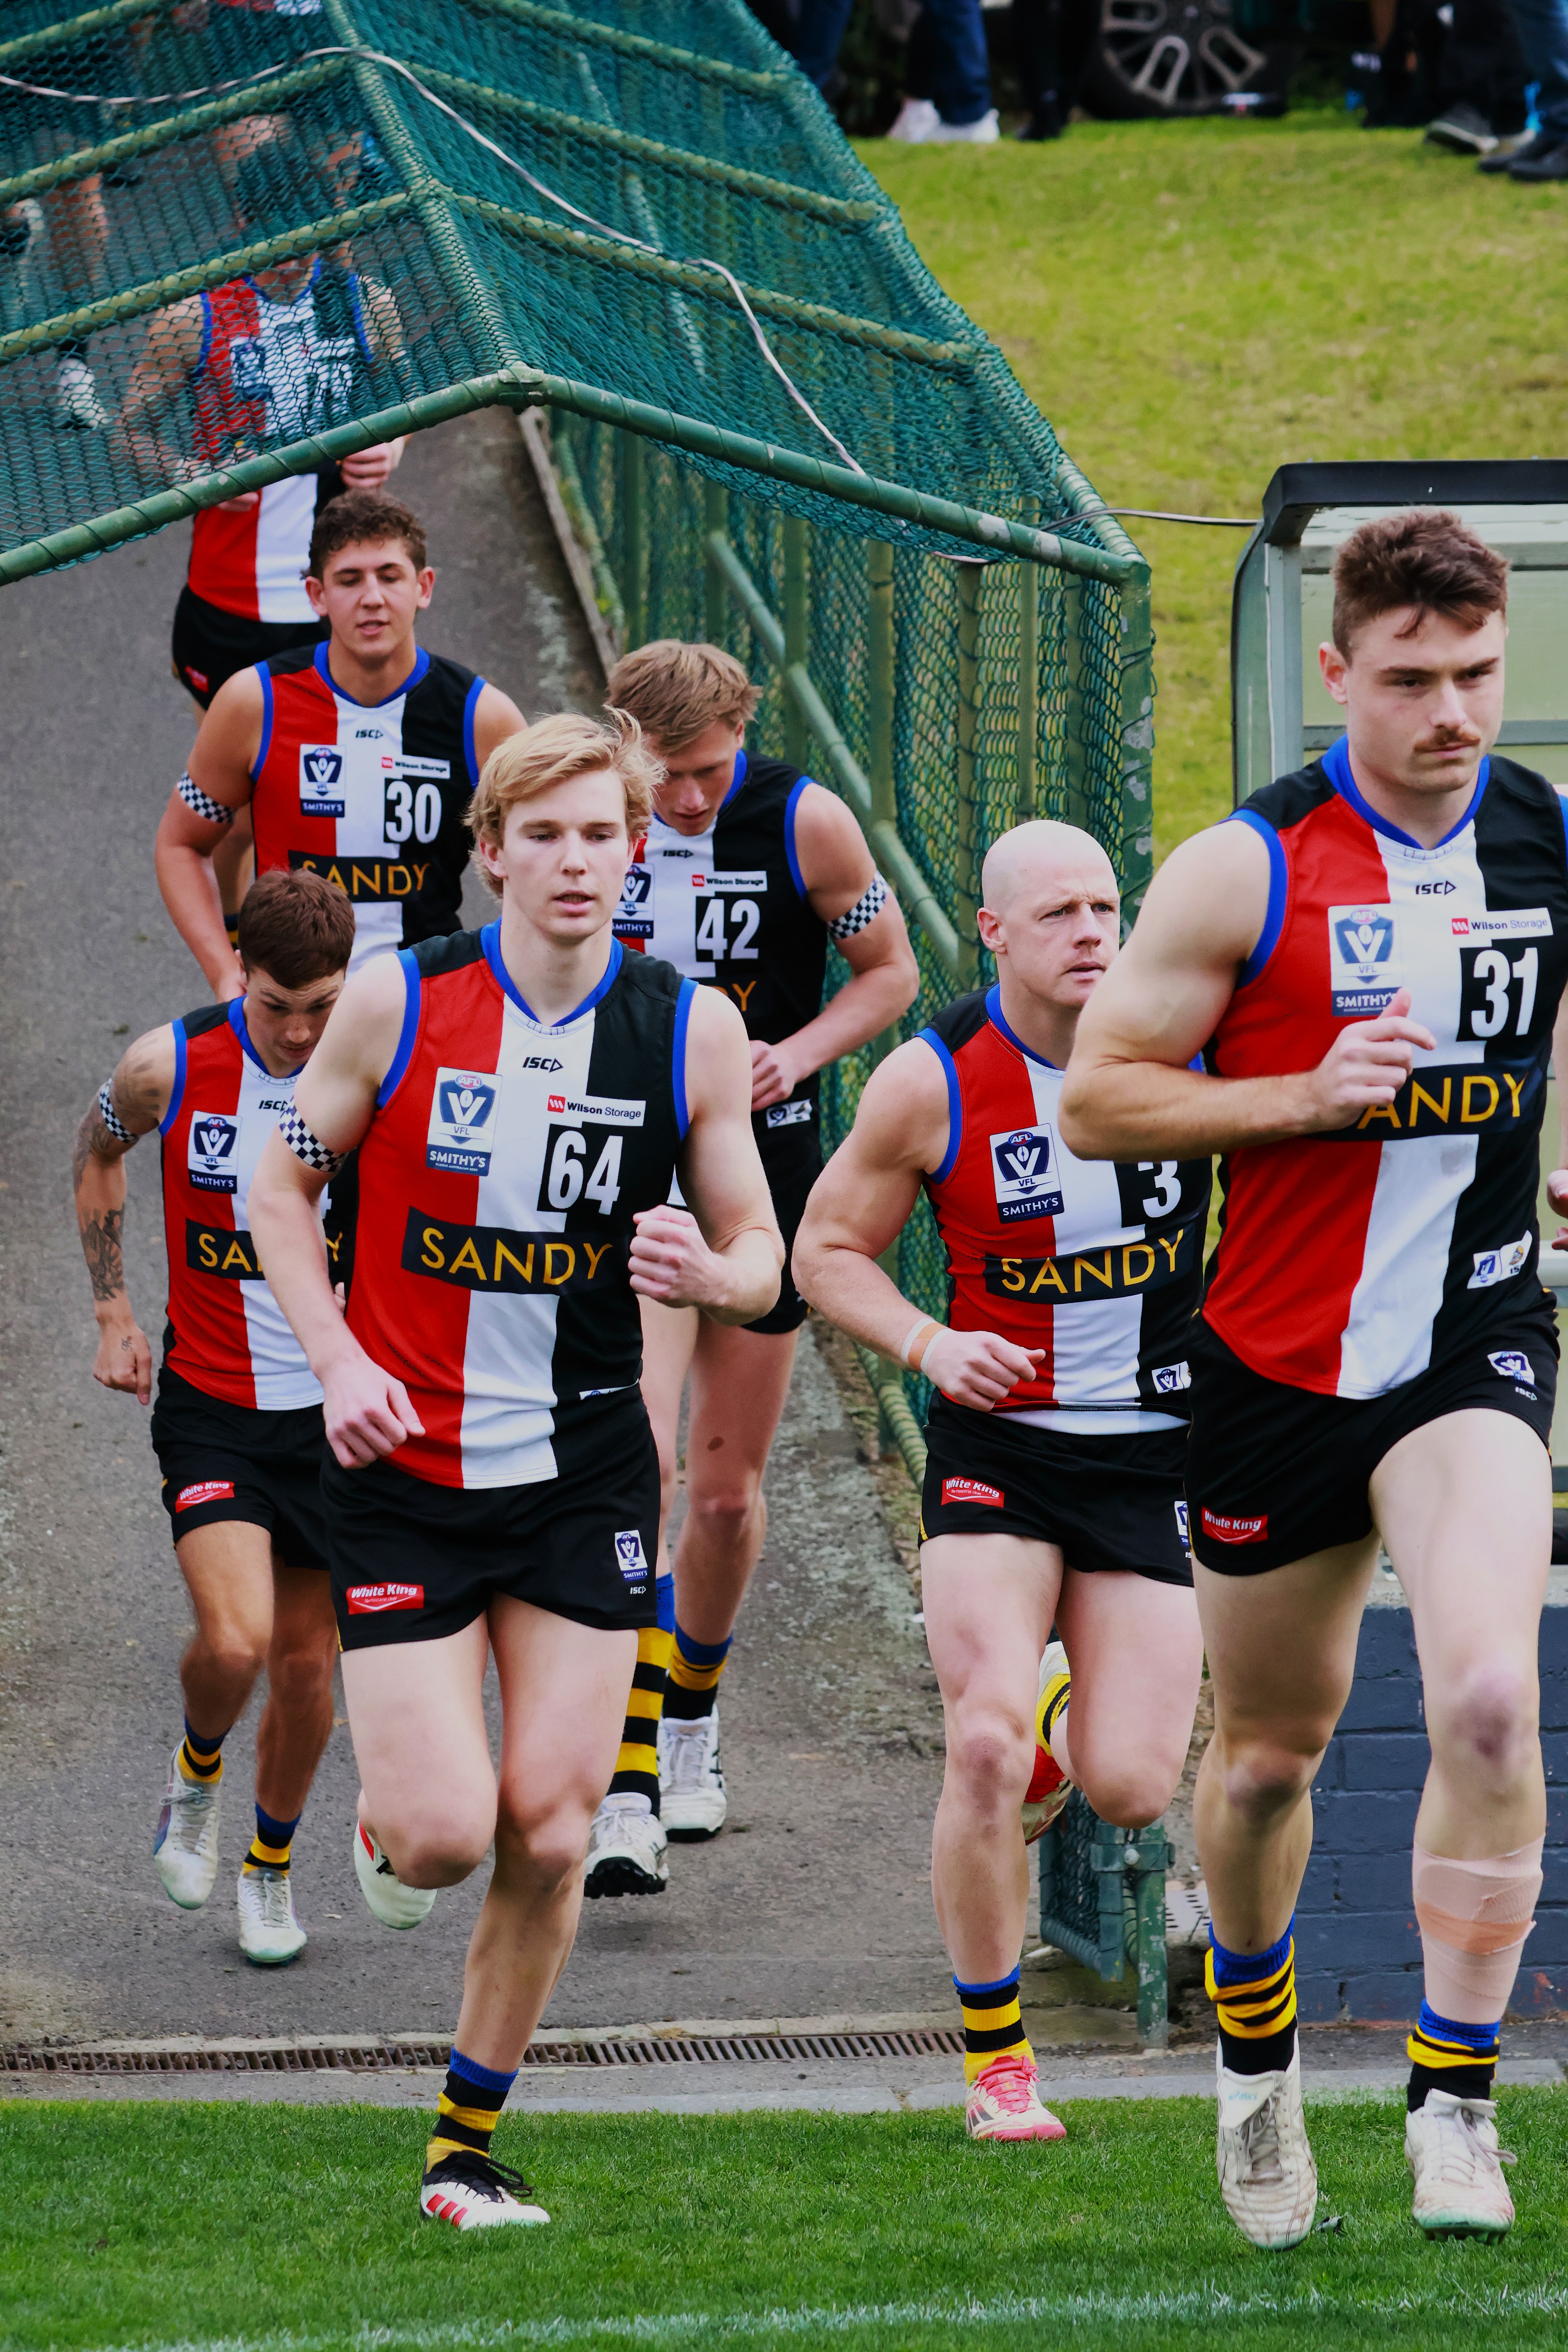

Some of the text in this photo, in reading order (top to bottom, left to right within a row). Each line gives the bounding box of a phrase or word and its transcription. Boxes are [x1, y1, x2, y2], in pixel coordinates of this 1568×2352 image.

[386, 780, 441, 843] 30
[697, 899, 760, 960] 42
[1472, 918, 1548, 931] Wilson Storage
[1471, 947, 1538, 1038] 31
[457, 1075, 479, 1086] AFL
[1357, 1073, 1528, 1129] ANDY
[567, 1102, 641, 1119] Wilson Storage
[454, 1126, 470, 1135] VFL
[1011, 1134, 1032, 1144] AFL
[430, 1150, 486, 1168] SMITHY'S
[191, 1174, 234, 1187] SMITHY'S
[548, 1131, 623, 1215] 64
[1018, 1178, 1036, 1187] VFL
[1002, 1198, 1059, 1216] SMITHY'S
[421, 1227, 613, 1285] SANDY
[1002, 1229, 1184, 1294] SANDY
[180, 1485, 203, 1501] White
[946, 1478, 971, 1490] White
[973, 1482, 1000, 1498] King
[1205, 1510, 1230, 1529] White
[1232, 1519, 1261, 1532] King
[351, 1584, 417, 1599] White King
